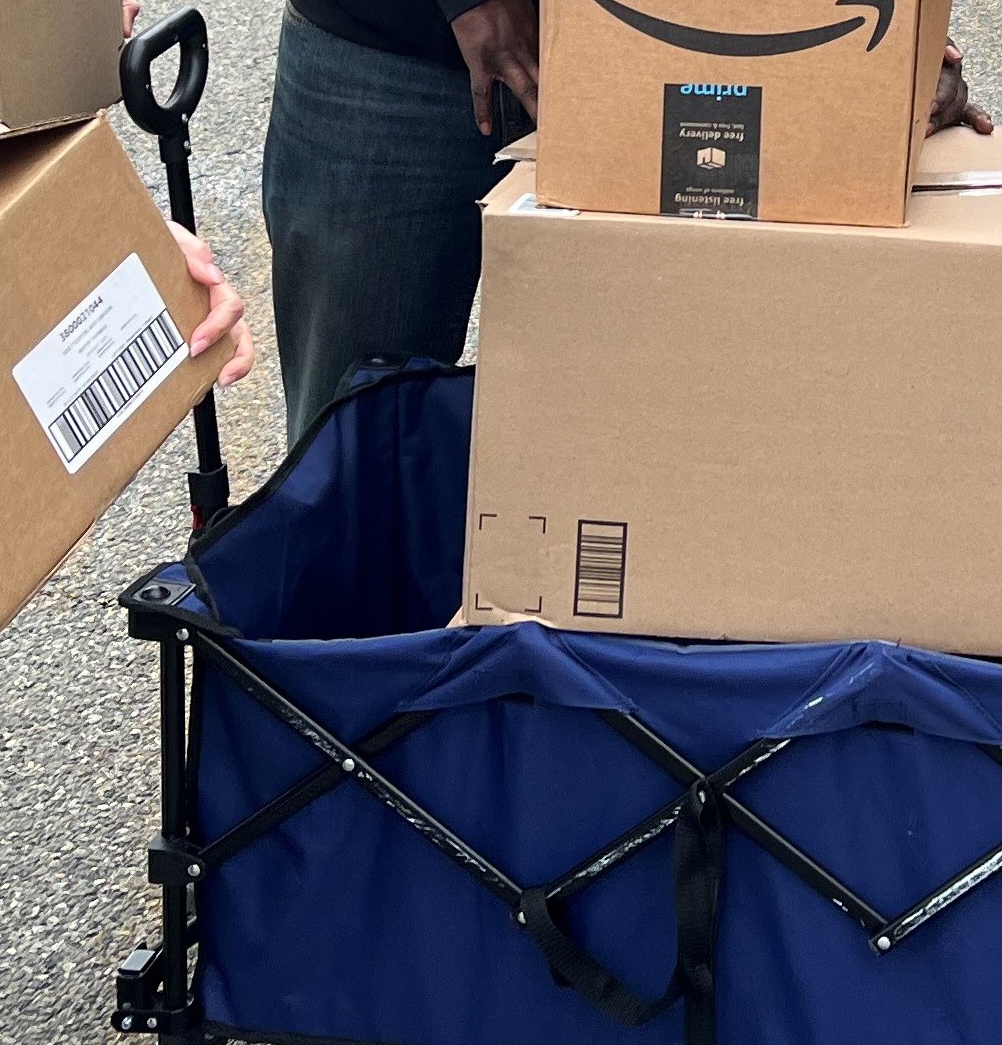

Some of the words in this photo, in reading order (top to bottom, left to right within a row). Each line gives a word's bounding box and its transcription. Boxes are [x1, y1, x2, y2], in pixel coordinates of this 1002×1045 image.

[679, 127, 721, 141] delivery
[723, 131, 745, 142] free
[674, 192, 721, 206] listening
[723, 196, 745, 207] free
